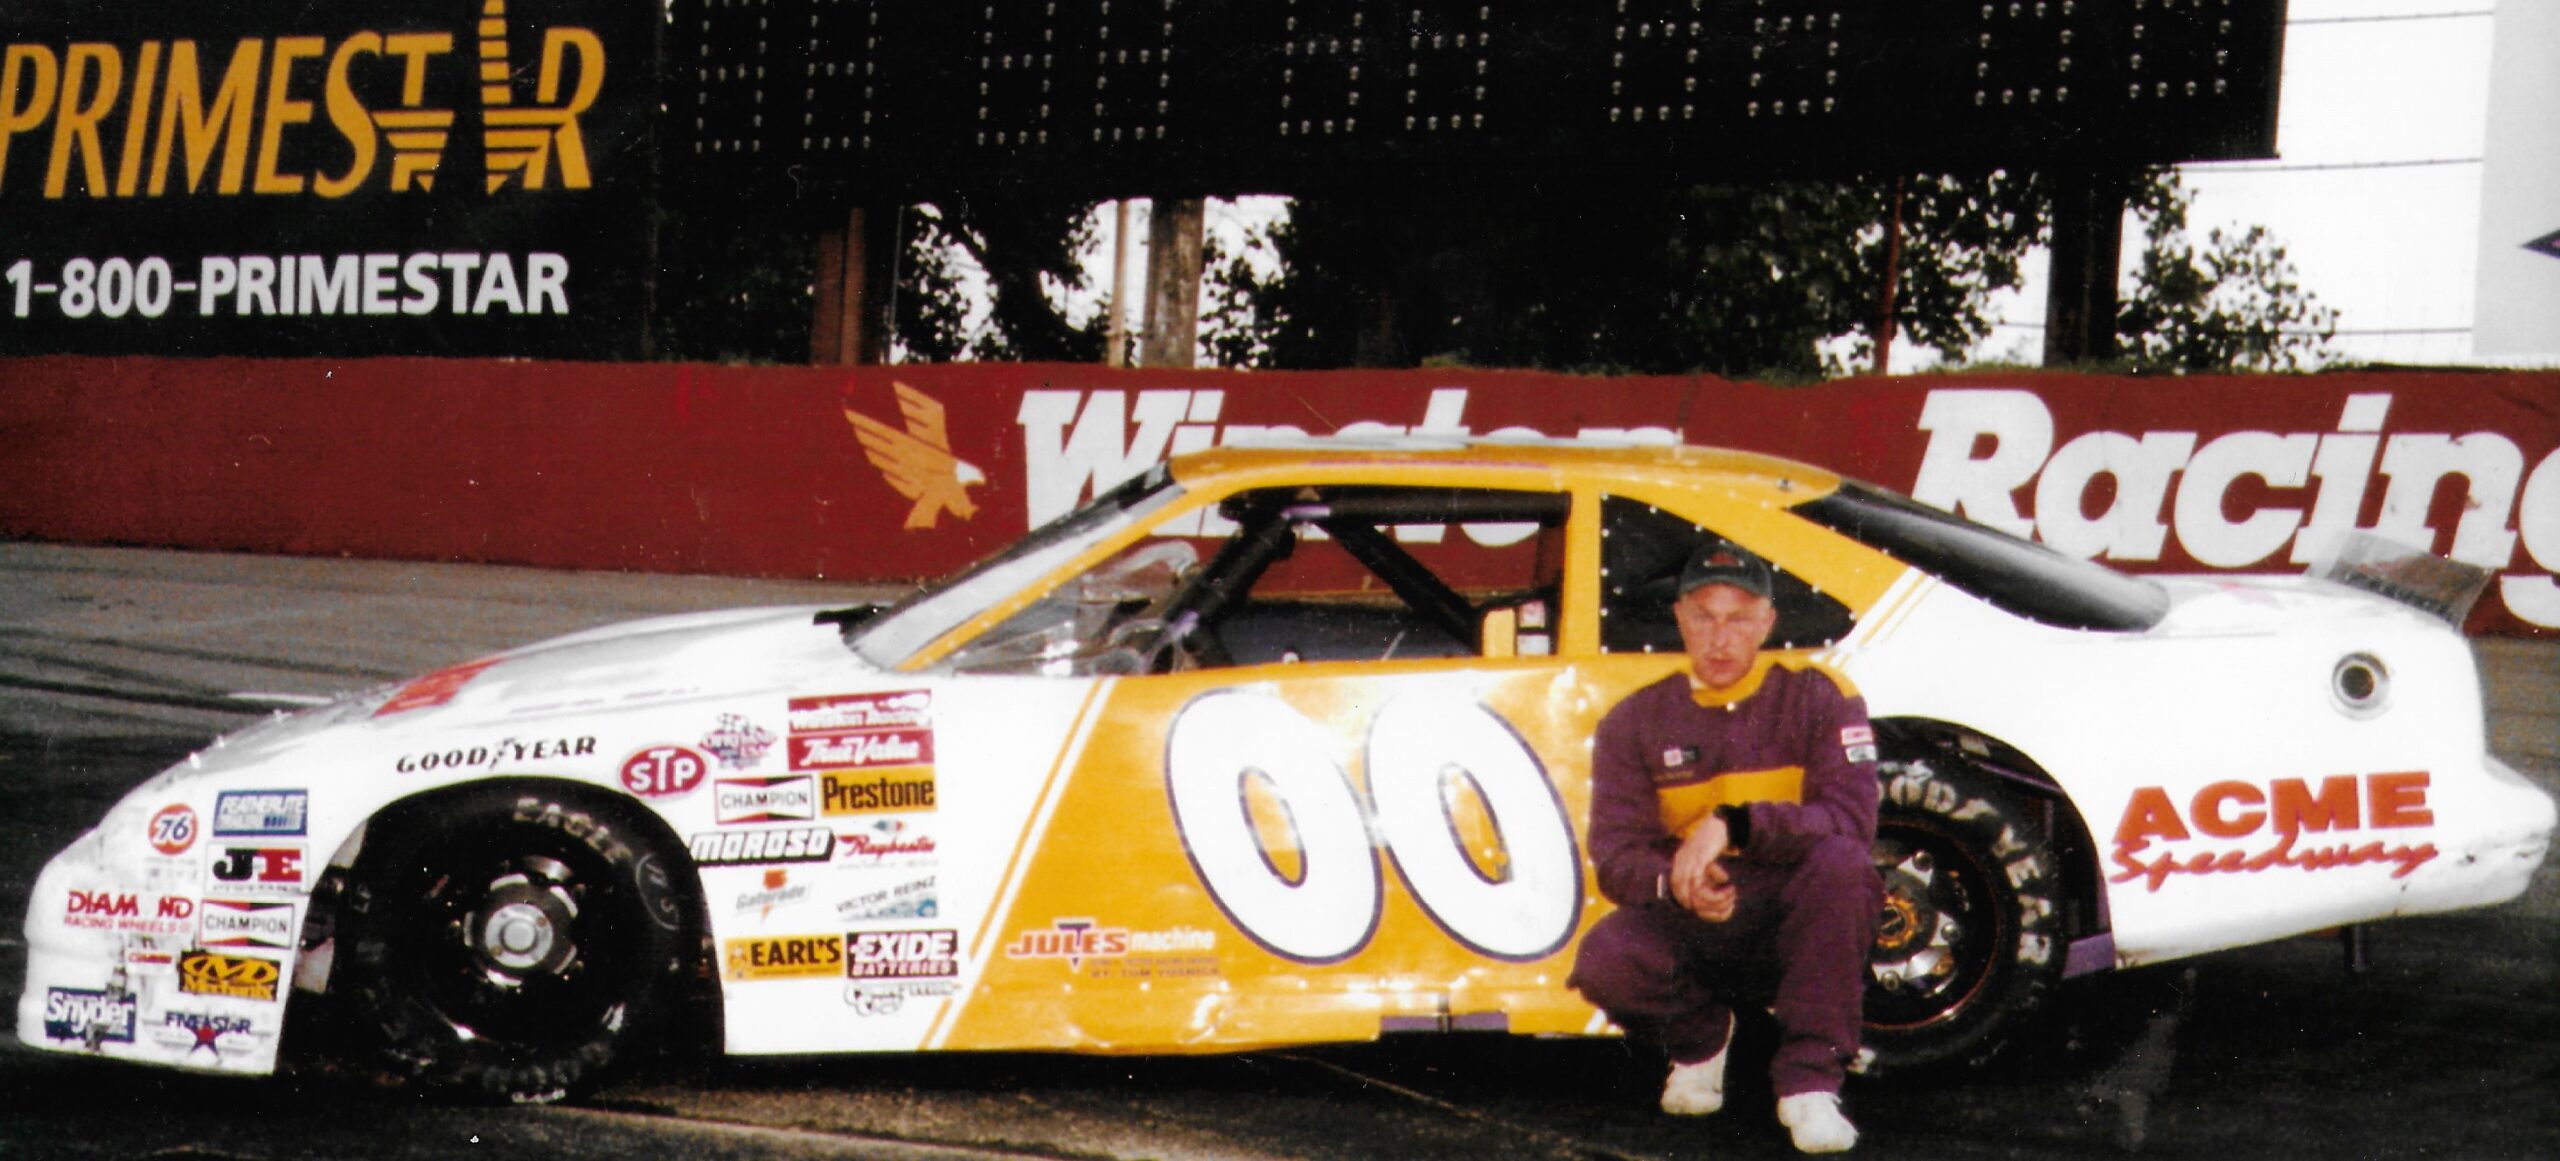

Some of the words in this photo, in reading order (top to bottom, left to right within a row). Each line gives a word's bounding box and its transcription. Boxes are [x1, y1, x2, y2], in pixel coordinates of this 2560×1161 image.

[0, 2, 606, 198] PRIMESTAR
[4, 253, 570, 318] 1-800-PRIMESTAR
[629, 750, 698, 792] STP
[719, 789, 808, 810] CHAMPION
[822, 775, 935, 812] Prestone
[2112, 771, 2435, 845] ACME
[157, 815, 190, 842] 76
[1164, 682, 1586, 966] 00
[689, 829, 834, 862] MOROSO
[212, 847, 302, 882] JE
[2110, 835, 2439, 892] Speedway
[736, 885, 806, 910] Gatorade
[836, 889, 888, 913] VICTOR
[893, 875, 936, 897] REINZ
[64, 914, 114, 930] RACING
[118, 919, 177, 935] WHEELS
[204, 914, 289, 934] CHAMPION
[1008, 931, 1128, 956] JULES
[1131, 926, 1215, 951] machine
[751, 936, 842, 967] EARL'S
[849, 932, 957, 962] EXIDE
[852, 960, 951, 977] BATTERIES
[46, 990, 135, 1033] Snyder
